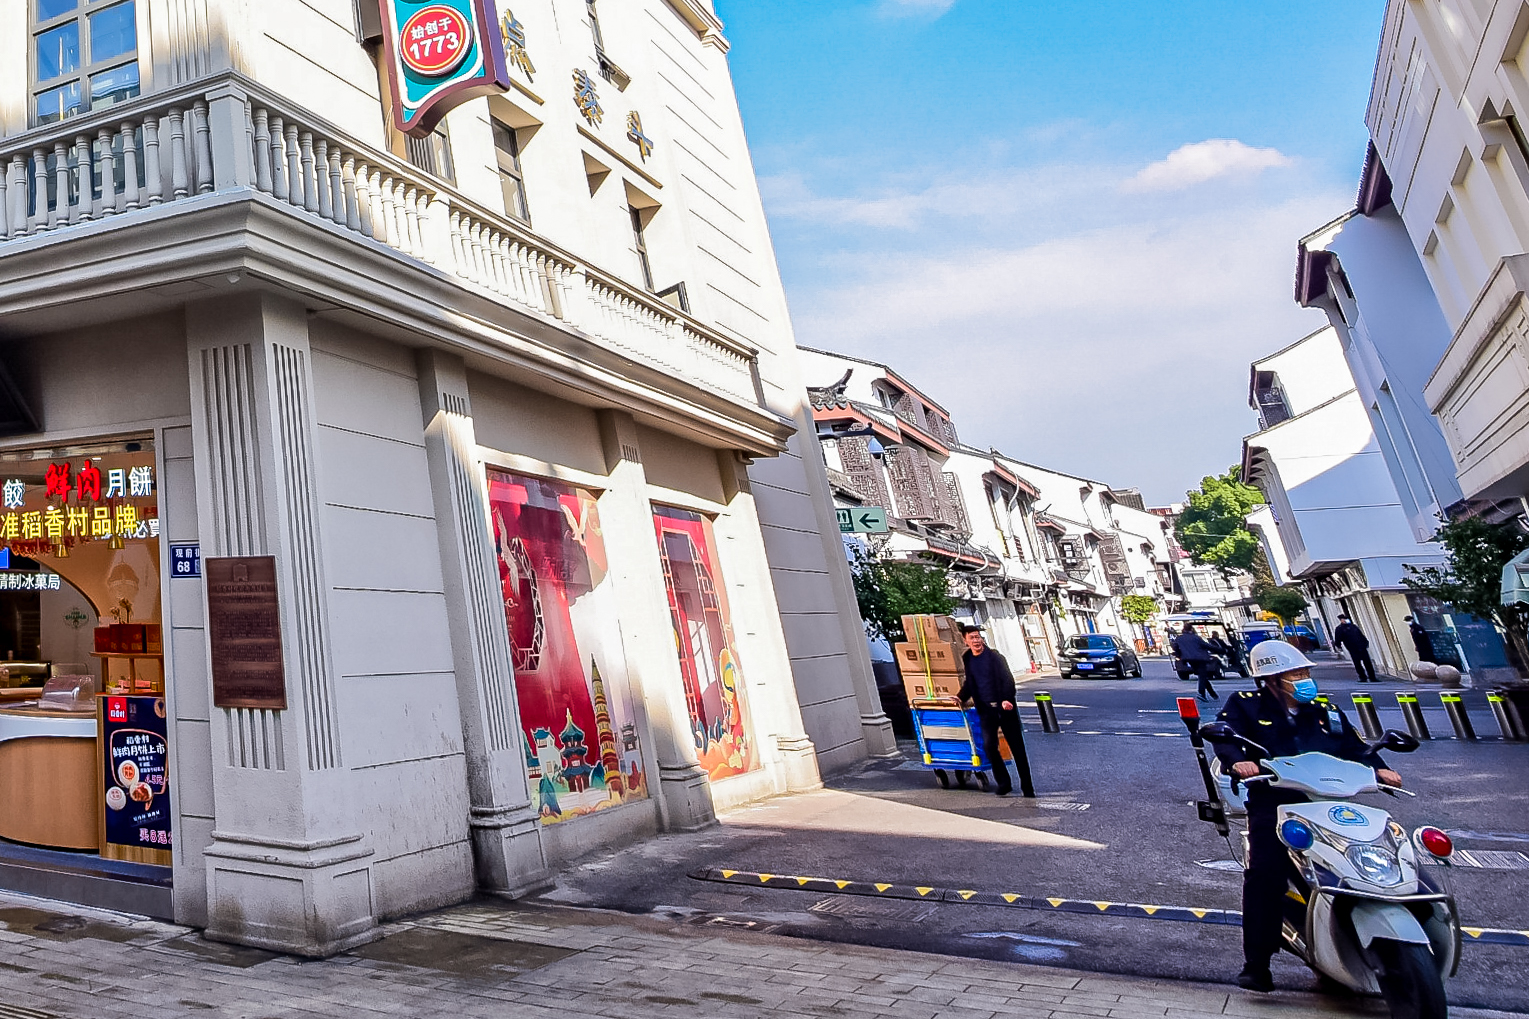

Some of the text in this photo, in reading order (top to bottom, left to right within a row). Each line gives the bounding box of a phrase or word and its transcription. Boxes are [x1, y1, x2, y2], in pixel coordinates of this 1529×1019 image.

[410, 17, 452, 40] 始创于
[409, 32, 459, 60] 1773
[176, 560, 190, 573] 68
[113, 742, 165, 758] 鲜肉月饼上市
